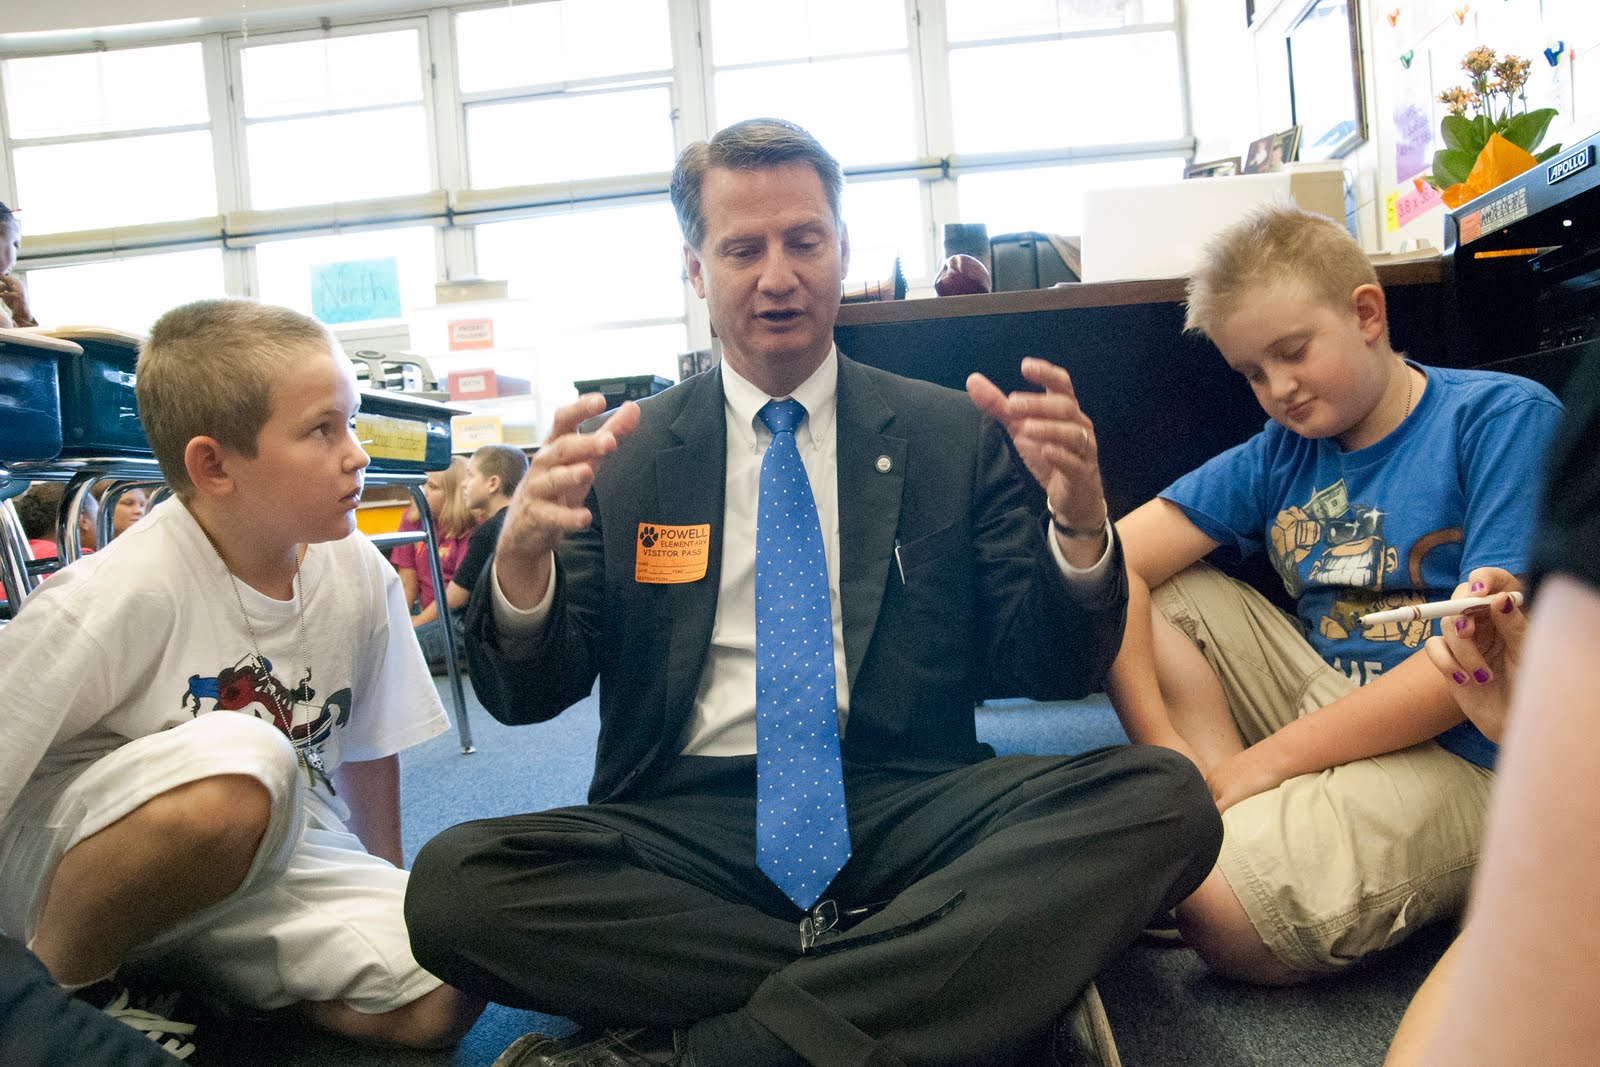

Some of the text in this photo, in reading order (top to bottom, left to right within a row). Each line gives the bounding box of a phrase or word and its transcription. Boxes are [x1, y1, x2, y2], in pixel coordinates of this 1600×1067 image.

[1549, 152, 1586, 180] APOLLO
[320, 265, 388, 312] North
[660, 528, 708, 539] POWELL
[660, 540, 707, 548] ELEMENTARY
[643, 549, 702, 557] VISITOR PASS
